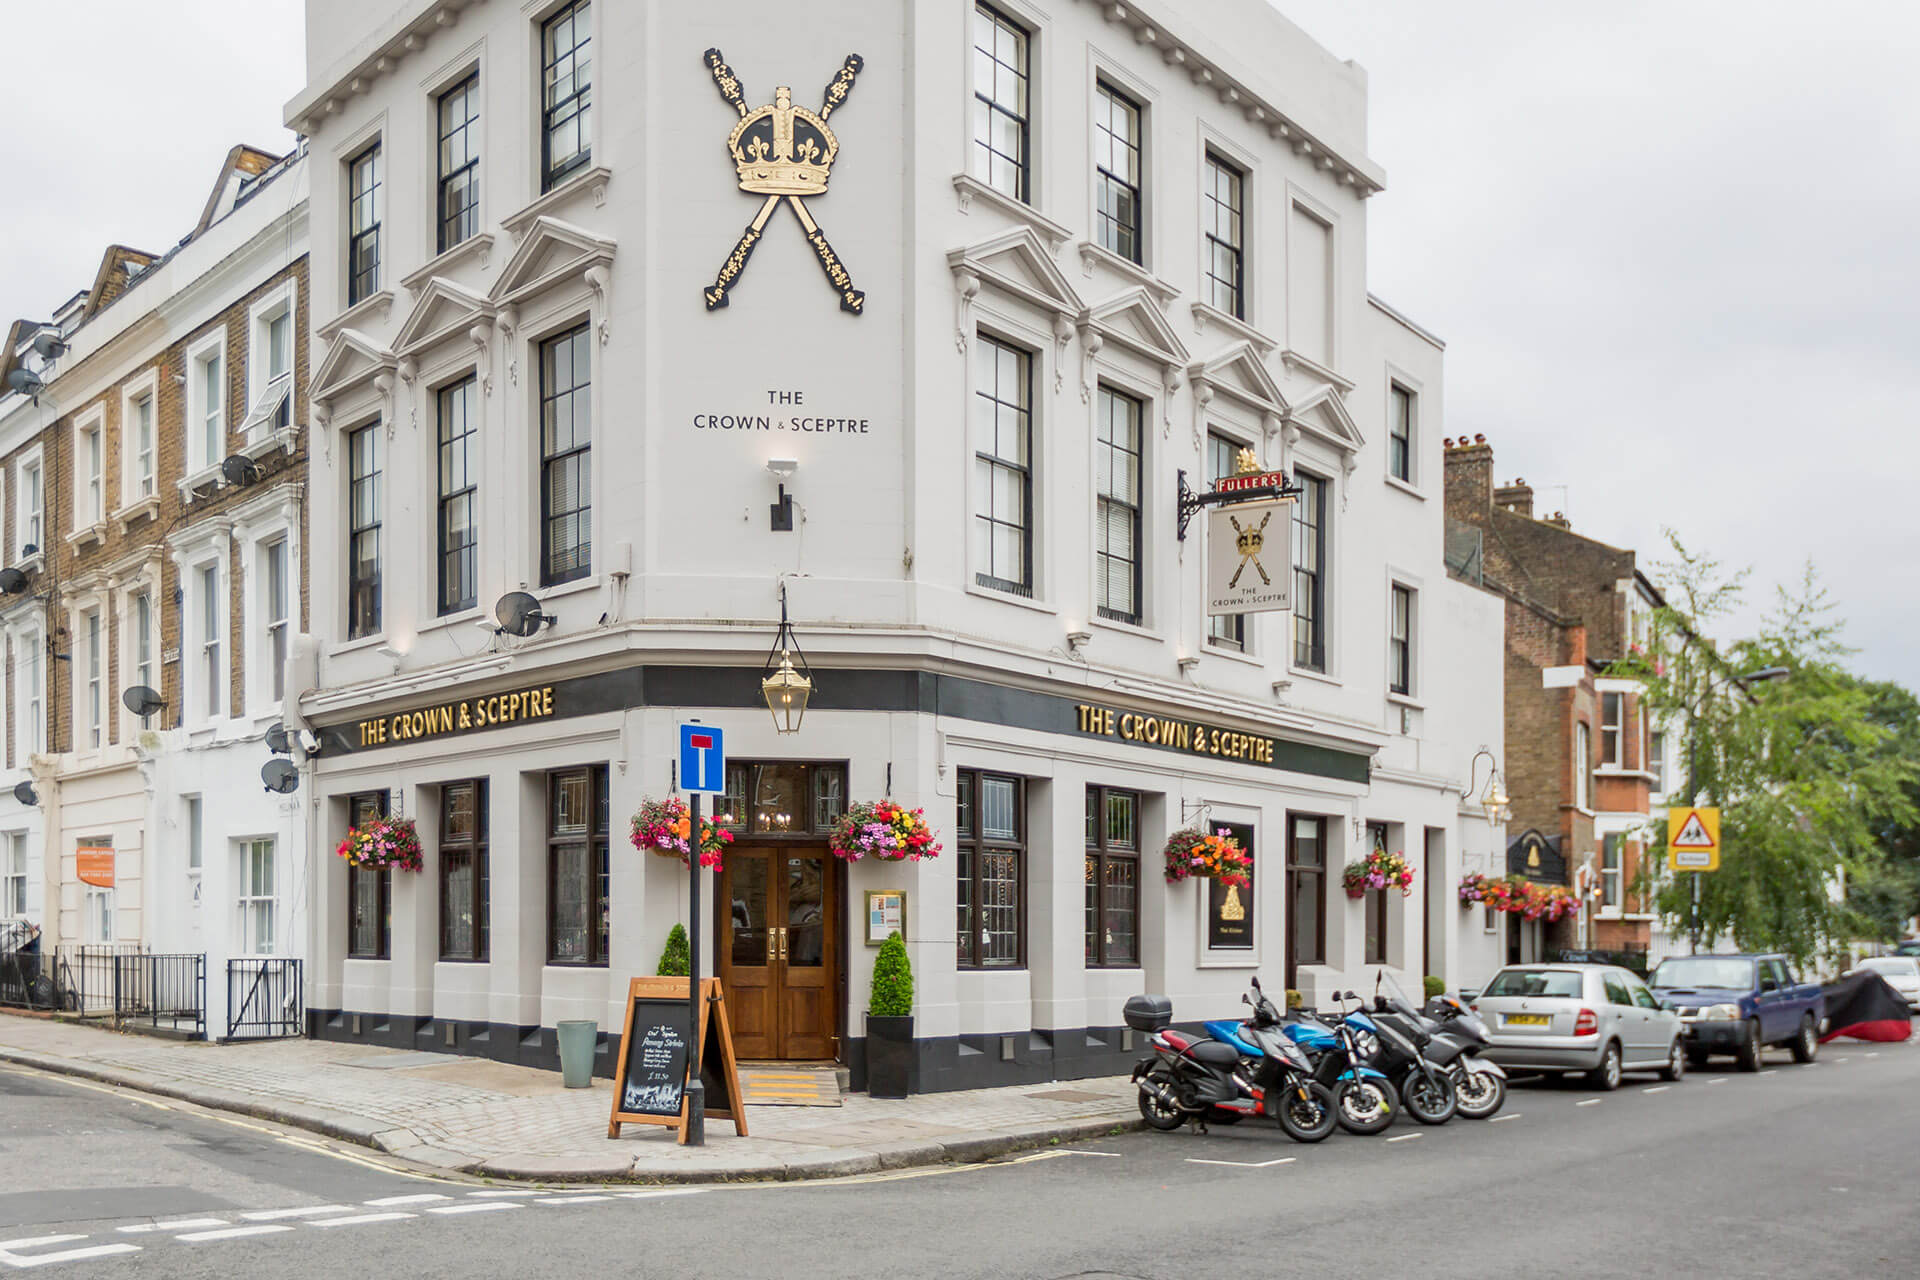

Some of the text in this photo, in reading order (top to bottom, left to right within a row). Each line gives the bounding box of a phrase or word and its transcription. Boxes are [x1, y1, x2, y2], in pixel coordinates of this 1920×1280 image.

[767, 390, 803, 405] THE
[693, 414, 869, 433] CROWN & SCEPTRE
[1219, 473, 1278, 493] FULLER'S
[1212, 598, 1244, 607] CROWN
[1252, 593, 1287, 604] SCEPTRE
[1242, 587, 1256, 595] THE
[359, 687, 554, 747] THE CROWN & SCEPTRE
[1077, 704, 1274, 764] THE CROWN & SCEPTRE
